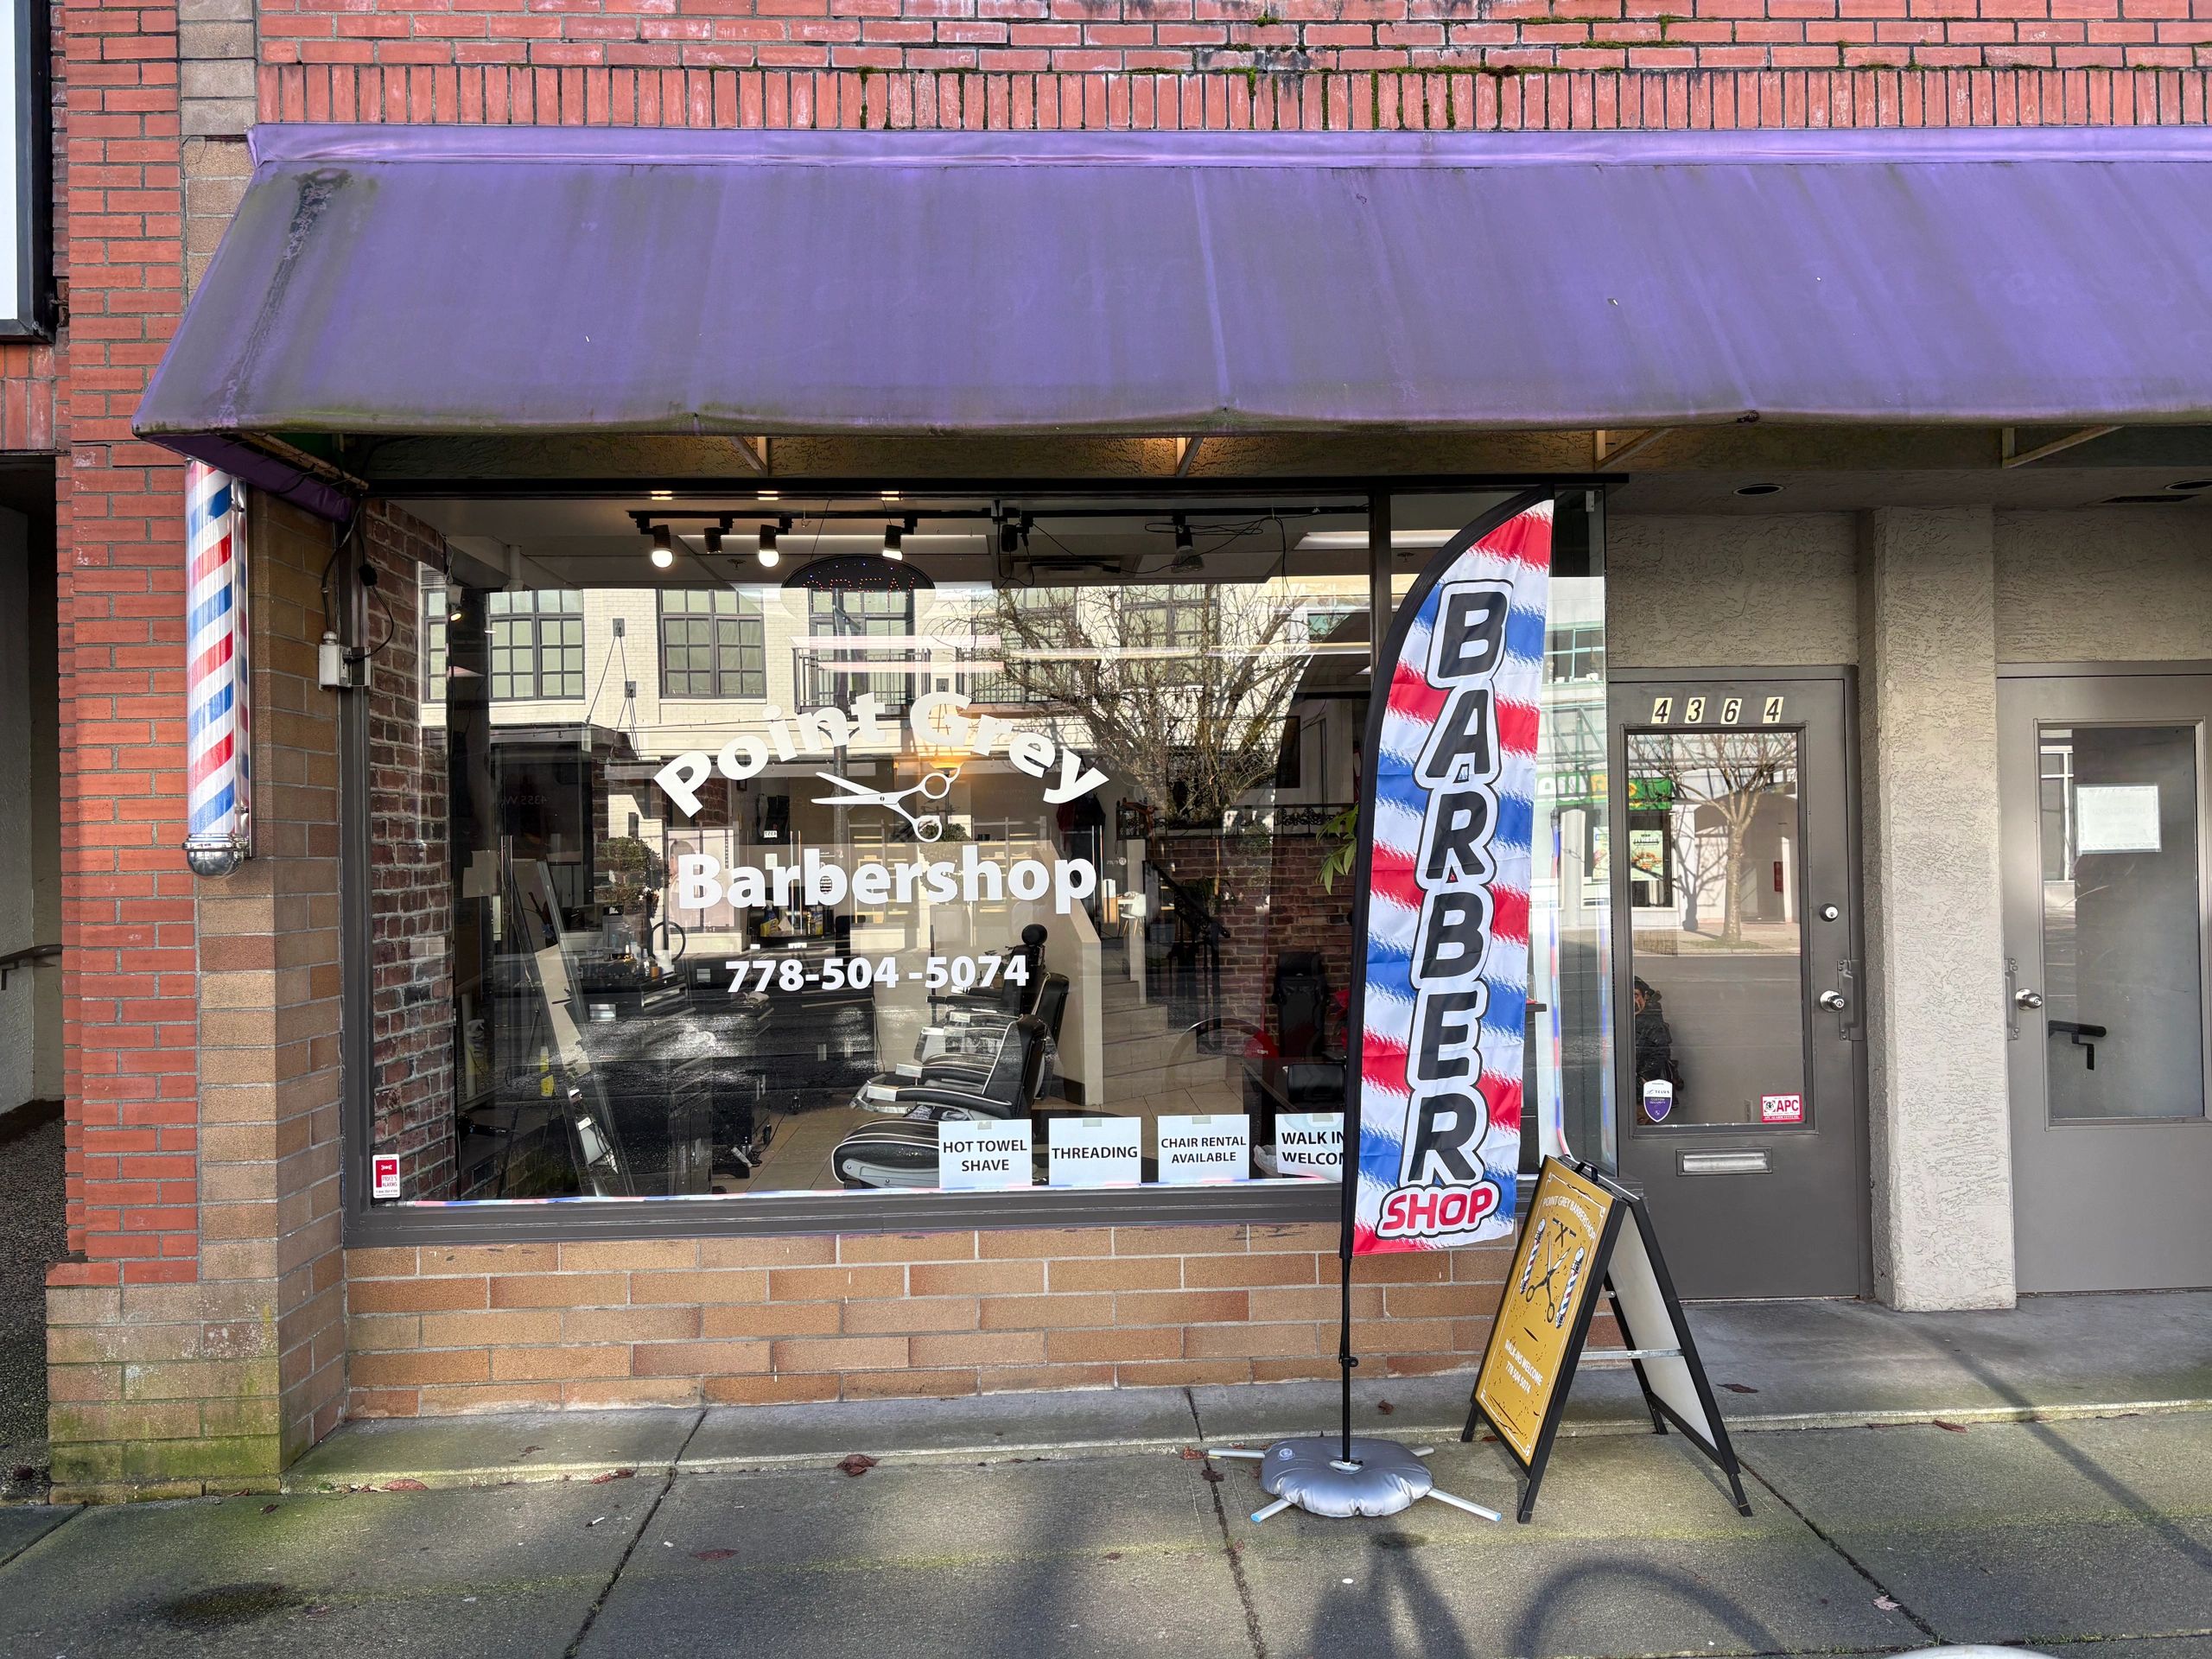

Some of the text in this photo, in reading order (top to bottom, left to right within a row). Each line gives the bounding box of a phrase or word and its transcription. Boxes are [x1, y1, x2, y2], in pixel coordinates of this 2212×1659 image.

[1654, 698, 1780, 723] 4364
[652, 690, 1110, 818] Point Grey
[677, 844, 1097, 915] Barbershop
[1402, 581, 1512, 1185] BARBER
[1777, 1099, 1799, 1112] APC
[943, 1140, 1027, 1153] HOT TOWEL
[1160, 1135, 1247, 1148] CHAIR RENTAL
[1281, 1131, 1327, 1145] WALK
[1052, 1146, 1138, 1160] THREADING
[1172, 1151, 1236, 1163] AVAILABLE
[961, 1159, 1009, 1172] SHAVE
[1381, 1185, 1496, 1232] SHOP
[1542, 1195, 1596, 1240] POINT GREY BARBERSHOP
[1522, 1357, 1543, 1386] WELCOME
